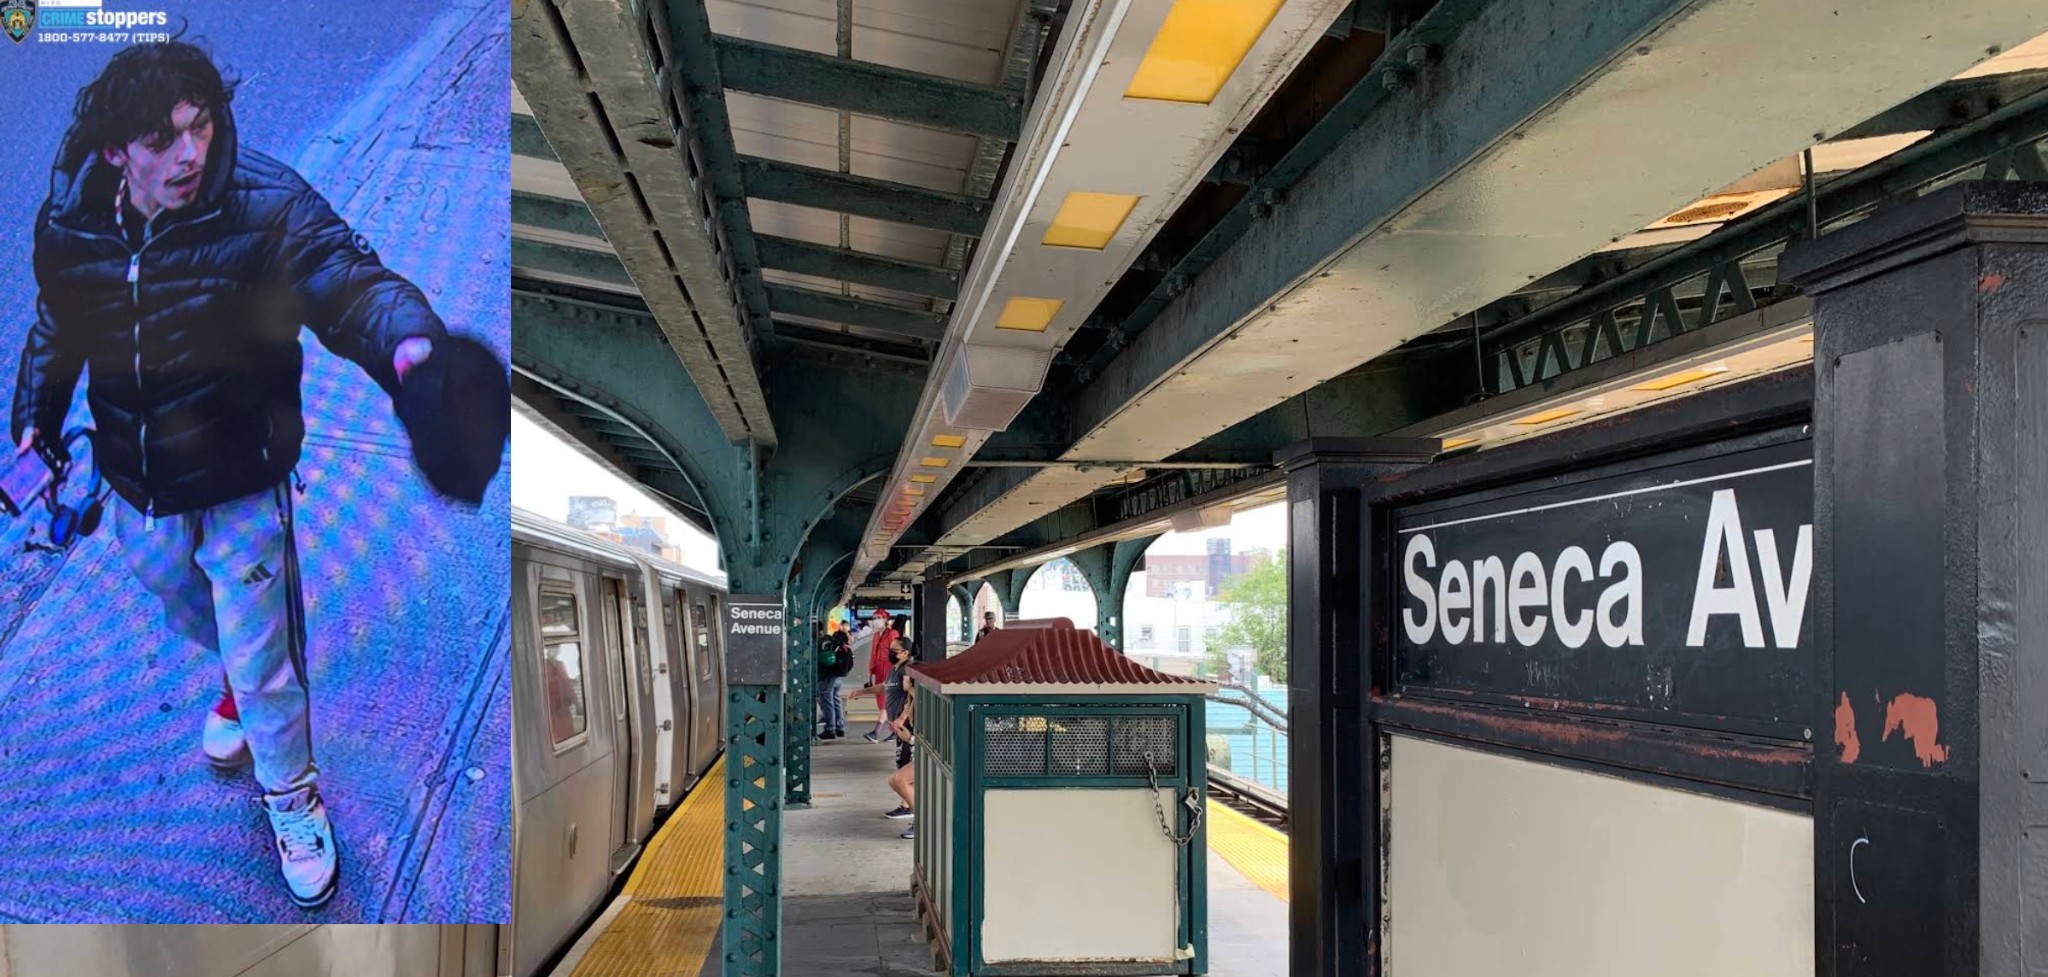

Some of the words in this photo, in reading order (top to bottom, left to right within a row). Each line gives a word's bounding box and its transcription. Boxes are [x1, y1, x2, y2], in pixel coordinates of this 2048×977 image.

[1402, 533, 1644, 648] Seneca
[731, 607, 782, 619] Seneca
[731, 622, 781, 635] Avenue
